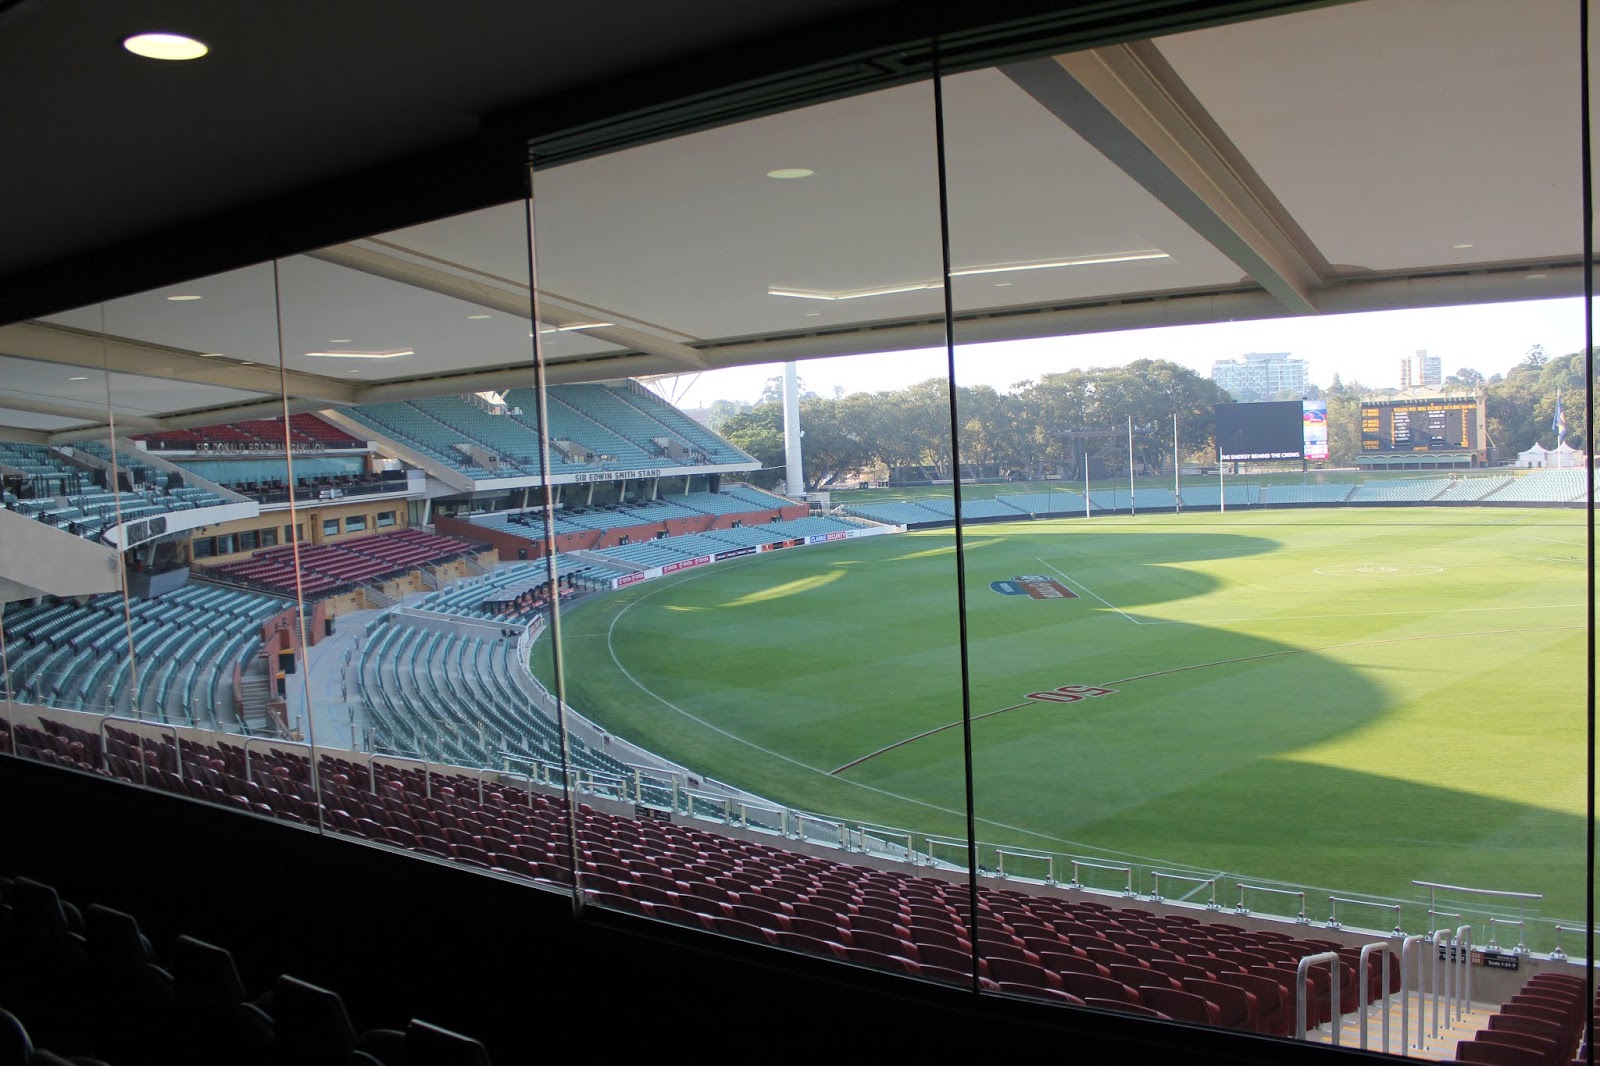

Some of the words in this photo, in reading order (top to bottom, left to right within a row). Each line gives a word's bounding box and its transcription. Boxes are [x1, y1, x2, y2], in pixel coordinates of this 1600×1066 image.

[196, 443, 209, 454] SIR
[213, 442, 245, 454] DONALD
[248, 442, 287, 454] BRADMAN
[291, 442, 326, 454] PAVILION
[589, 473, 612, 481] EDWIN
[615, 471, 636, 480] SMITH
[638, 470, 661, 478] STAND
[827, 532, 846, 540] SECURITY
